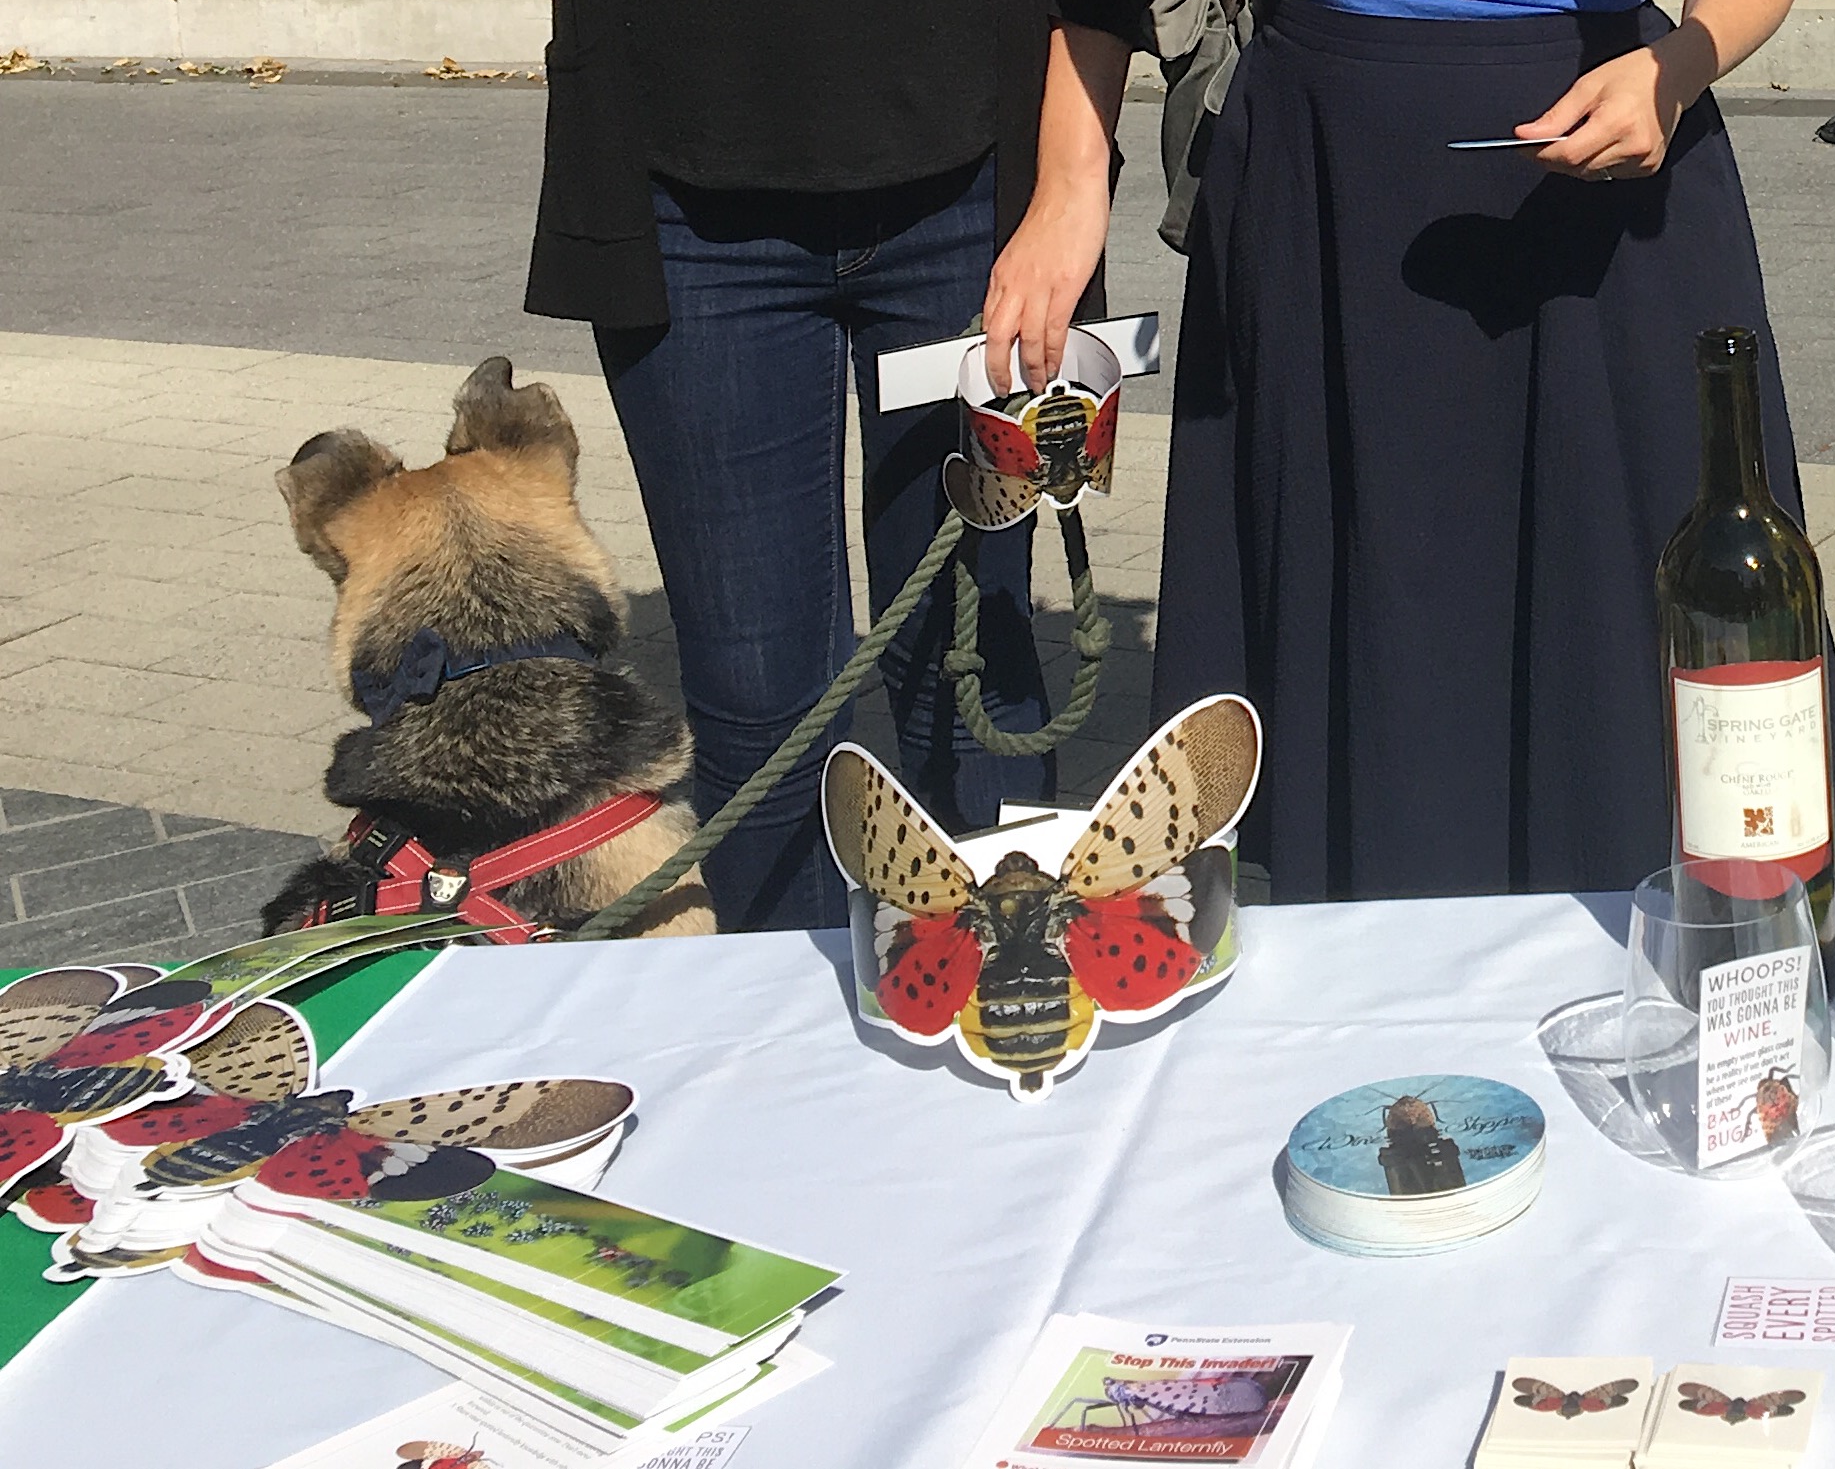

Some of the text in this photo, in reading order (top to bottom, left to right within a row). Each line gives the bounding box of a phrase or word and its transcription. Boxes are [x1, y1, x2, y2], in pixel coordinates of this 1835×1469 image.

[1708, 704, 1817, 732] SPRING GATE
[1708, 720, 1817, 743] VINEYARD
[1708, 955, 1801, 993] WHOOPS!
[1708, 977, 1799, 1013] YOU THOUGHT THIS
[1707, 993, 1797, 1032] WAS GONNA BE
[1724, 1020, 1777, 1047] WINE.
[1707, 1108, 1741, 1129] BAD
[1722, 1285, 1766, 1339] SQUASH
[1762, 1286, 1812, 1341] EVERY
[1170, 1336, 1220, 1344] PennState
[1110, 1353, 1275, 1370] Stop This Invader!
[695, 1447, 724, 1457] THIS
[1054, 1433, 1234, 1456] Spotted Lanternfly
